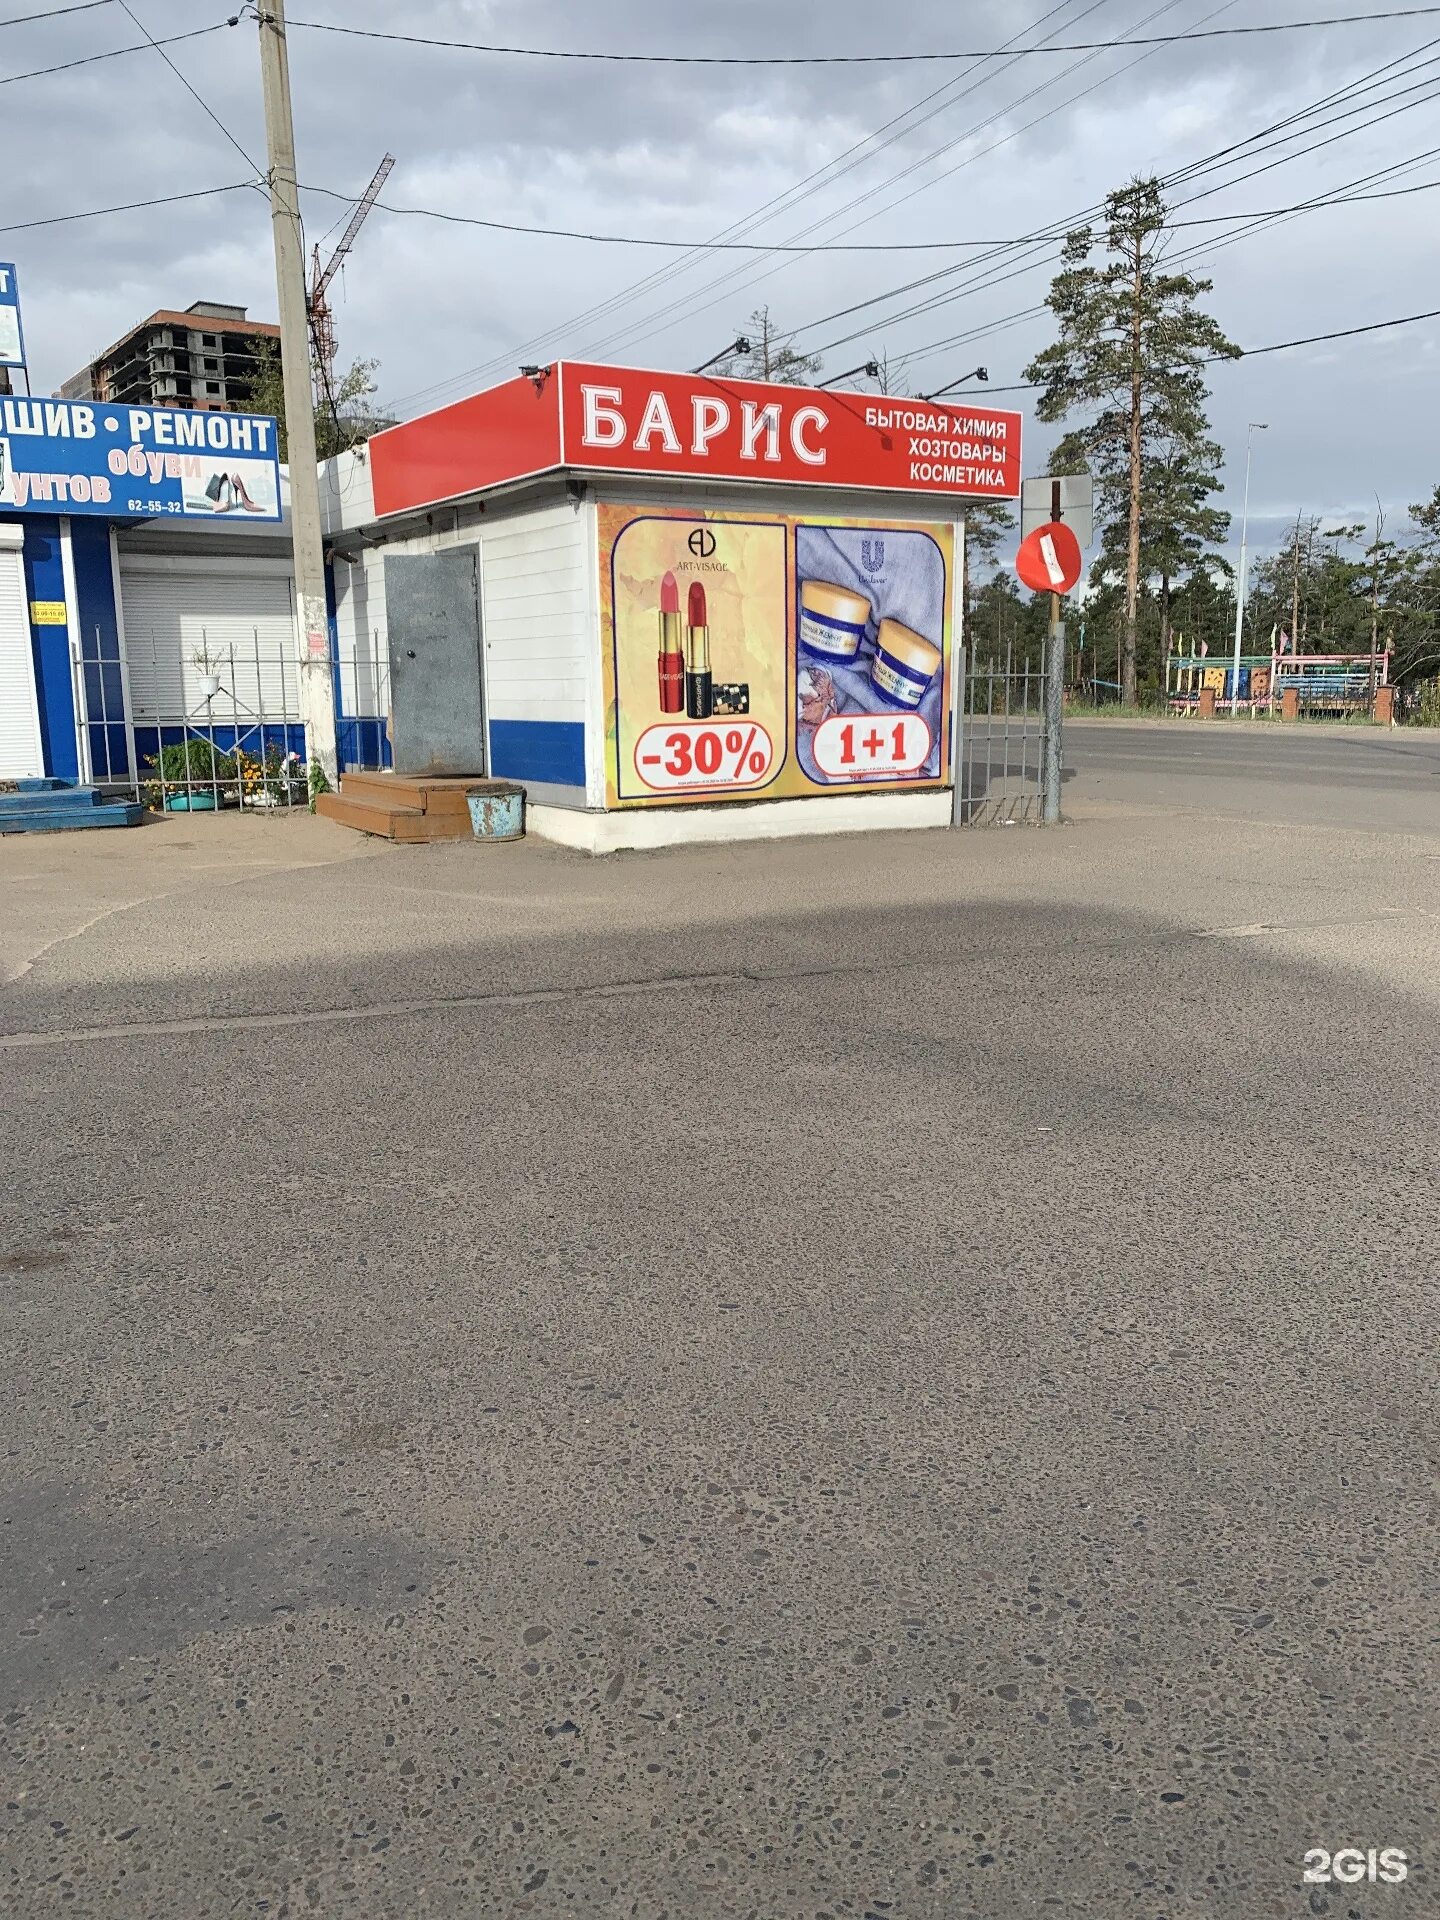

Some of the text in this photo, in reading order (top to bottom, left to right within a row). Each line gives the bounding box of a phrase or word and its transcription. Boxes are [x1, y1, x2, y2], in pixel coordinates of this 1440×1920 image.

[0, 400, 271, 452] ШИВ РЕМОНТ
[580, 383, 830, 466] БАРИС
[865, 407, 1007, 440] БЫТОВАЯ ХИМИЯ
[107, 443, 202, 485] обуви
[908, 437, 1006, 464] ХОЗТОВАРЫ
[10, 471, 112, 508] унтов
[910, 462, 1006, 487] КОСМЕТИКА
[128, 499, 181, 513] 62-55-32
[677, 561, 728, 572] ART-VISAGE
[642, 727, 766, 779] -30%
[840, 722, 907, 764] 1+1
